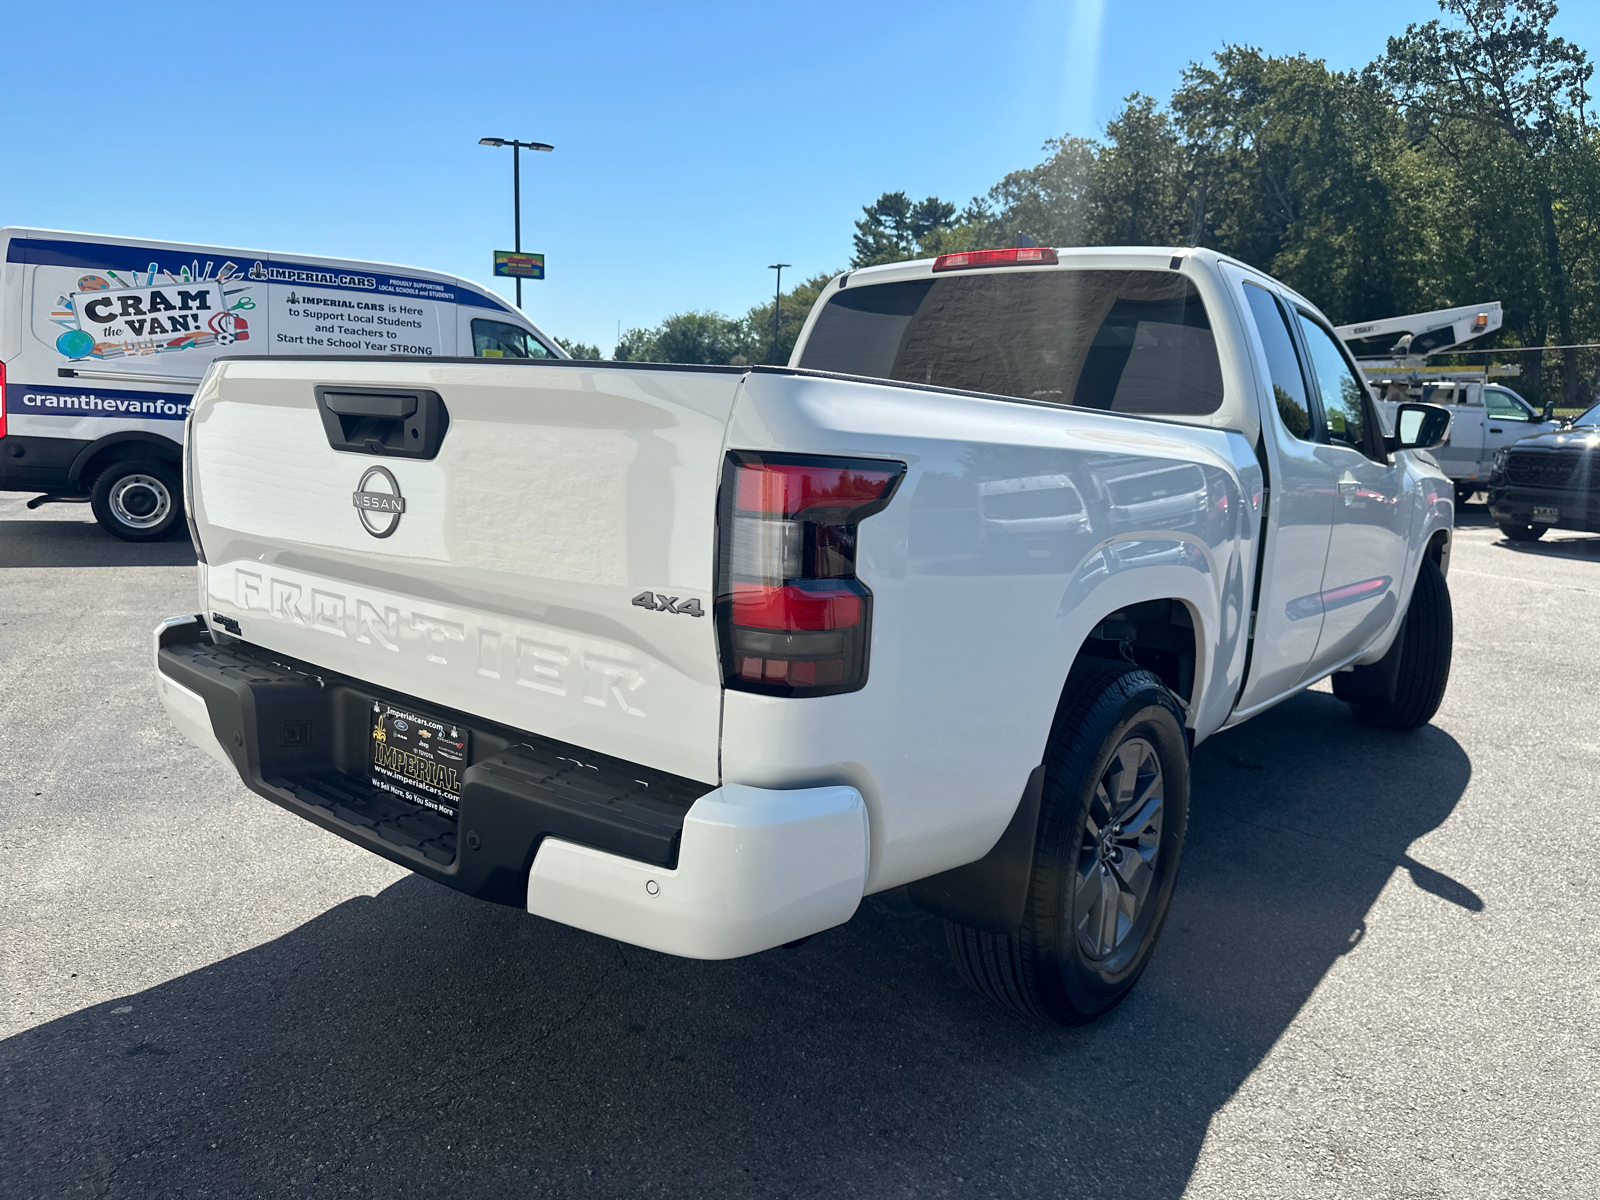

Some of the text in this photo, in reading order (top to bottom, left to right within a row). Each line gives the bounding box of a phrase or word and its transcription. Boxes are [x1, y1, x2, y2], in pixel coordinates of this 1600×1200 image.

[269, 268, 376, 289] IMPERIAL CARS
[389, 279, 444, 292] PROUDLY SUPPORTING
[379, 285, 395, 293] LOCAL
[396, 287, 419, 296] SCHOOLS
[429, 291, 455, 300] STUDENTS
[85, 290, 211, 323] CRAM
[302, 296, 424, 316] IMPERIAL CARS is Here
[102, 313, 201, 338] the VAN!
[289, 307, 422, 329] to Support Local Students
[314, 324, 397, 339] and Teachers to
[276, 333, 433, 355] Start the School Year STRONG
[353, 494, 402, 511] NISSAN
[234, 567, 648, 718] FRONTIER
[386, 706, 444, 731] Imperialcars.com
[418, 749, 434, 760] TOYOTA
[375, 741, 461, 795] IMPERIAL
[374, 764, 460, 802] www.imperialcars.com
[372, 778, 454, 816] We Sell More, So You Save More
